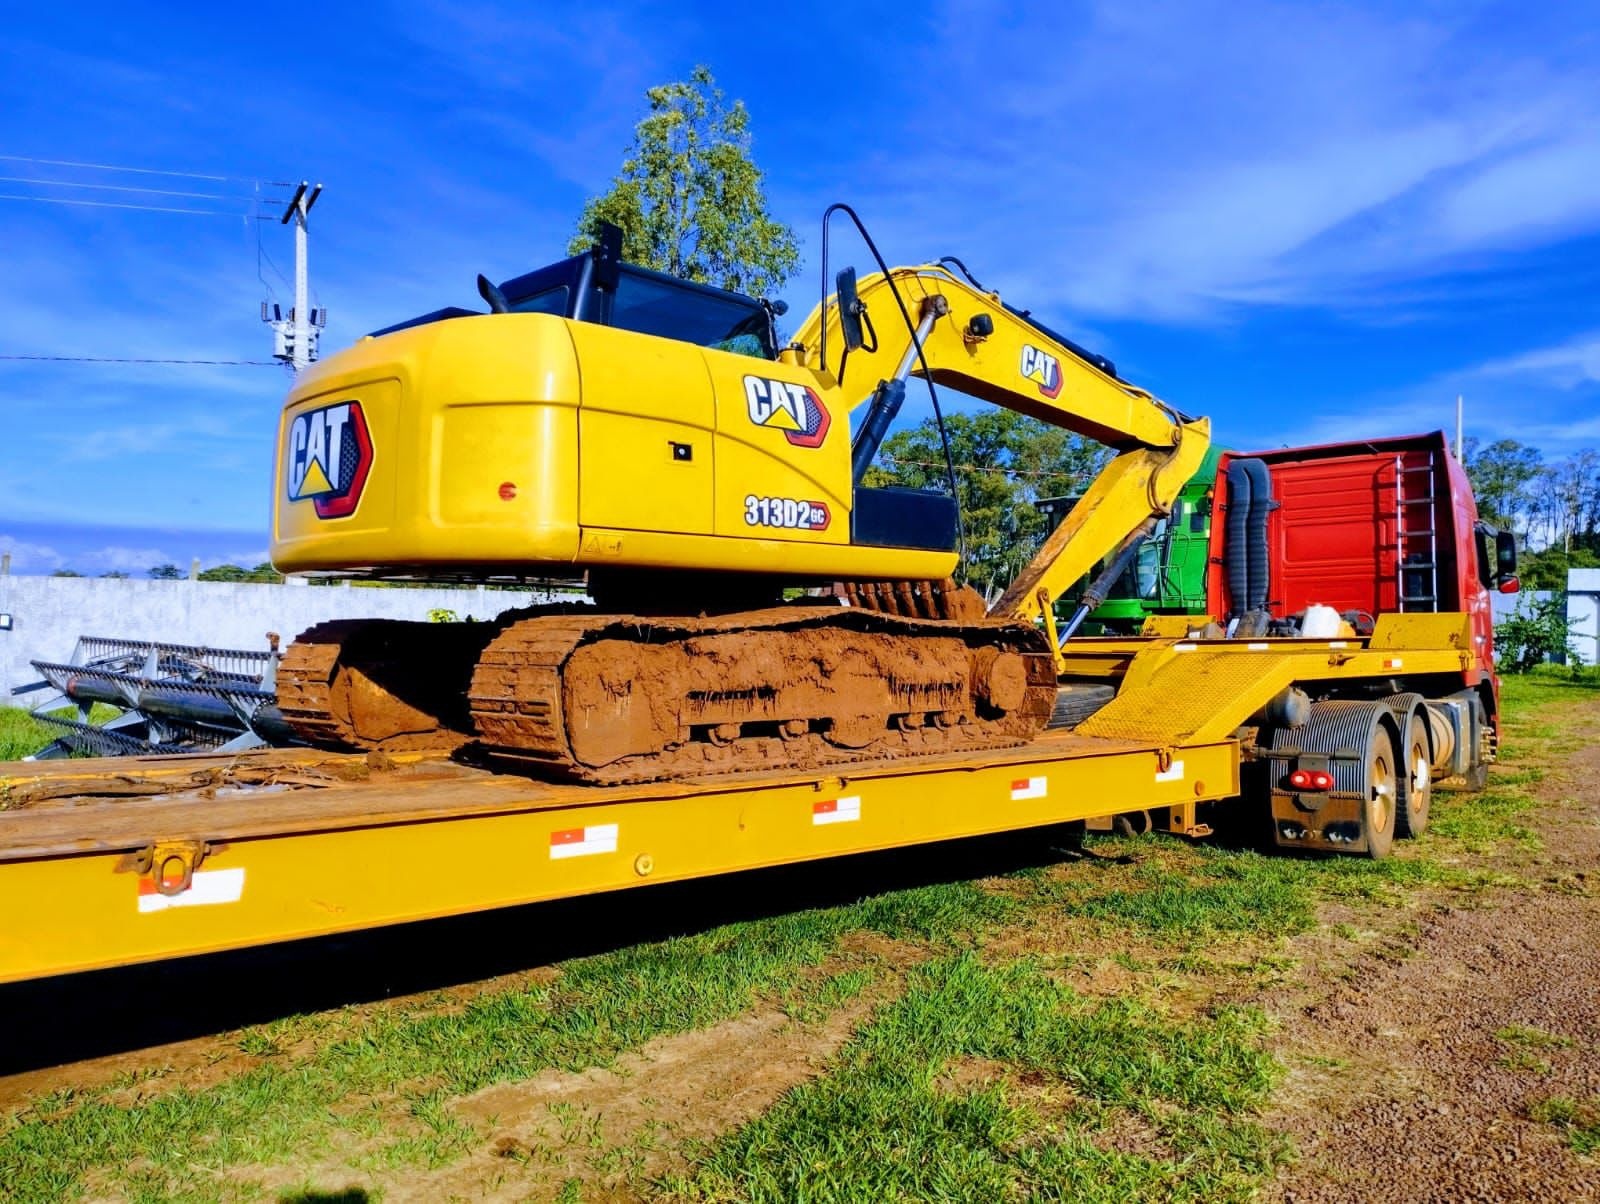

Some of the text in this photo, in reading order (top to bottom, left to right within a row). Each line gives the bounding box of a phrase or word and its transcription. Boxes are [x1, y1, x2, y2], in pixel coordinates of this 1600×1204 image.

[1022, 345, 1056, 387] CAT
[743, 375, 807, 431] CAT
[288, 403, 350, 498] CAT
